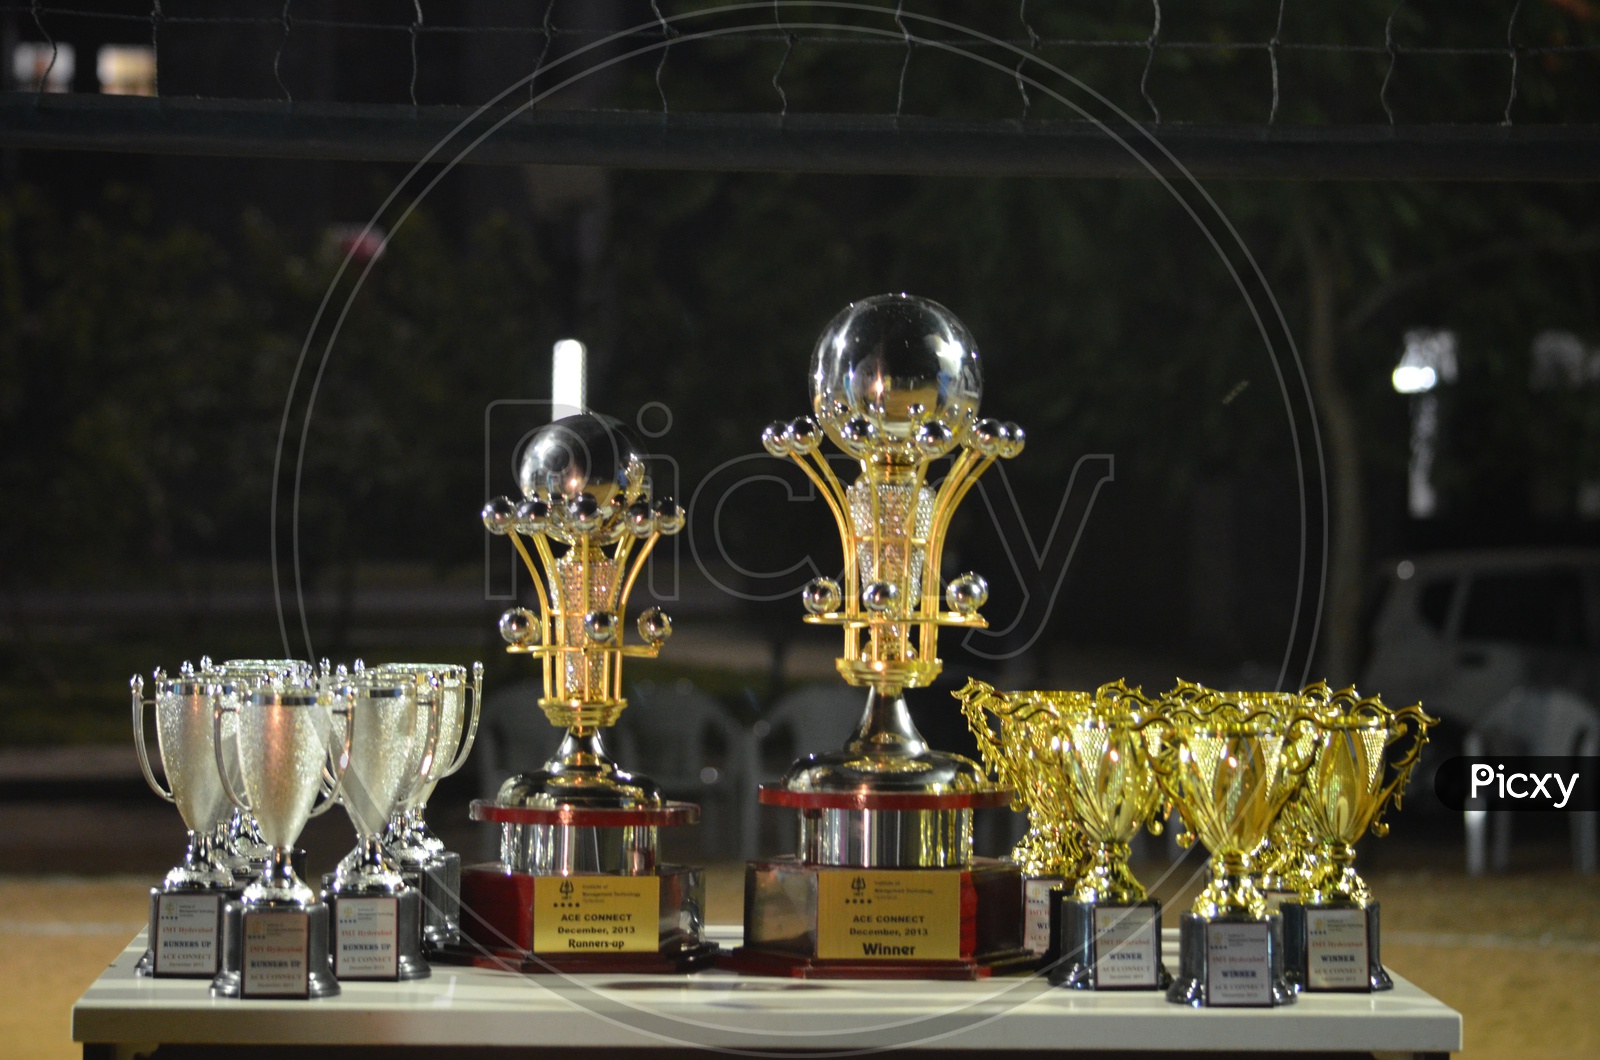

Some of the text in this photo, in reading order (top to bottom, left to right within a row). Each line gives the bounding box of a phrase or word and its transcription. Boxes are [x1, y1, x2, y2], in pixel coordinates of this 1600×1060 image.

[561, 913, 633, 922] ACE CONNECT
[852, 915, 925, 924] ACE CONNECT
[557, 926, 636, 935] December, 2013
[849, 927, 929, 937] December, 2013
[163, 940, 212, 948] RUNNERS UP
[342, 943, 392, 951] RUNNERS UP
[568, 938, 625, 950] Runners-up
[862, 942, 916, 956] Winner
[1109, 952, 1143, 960] WINNER
[1320, 954, 1356, 962] WINNER
[1221, 970, 1257, 979] WINNER
